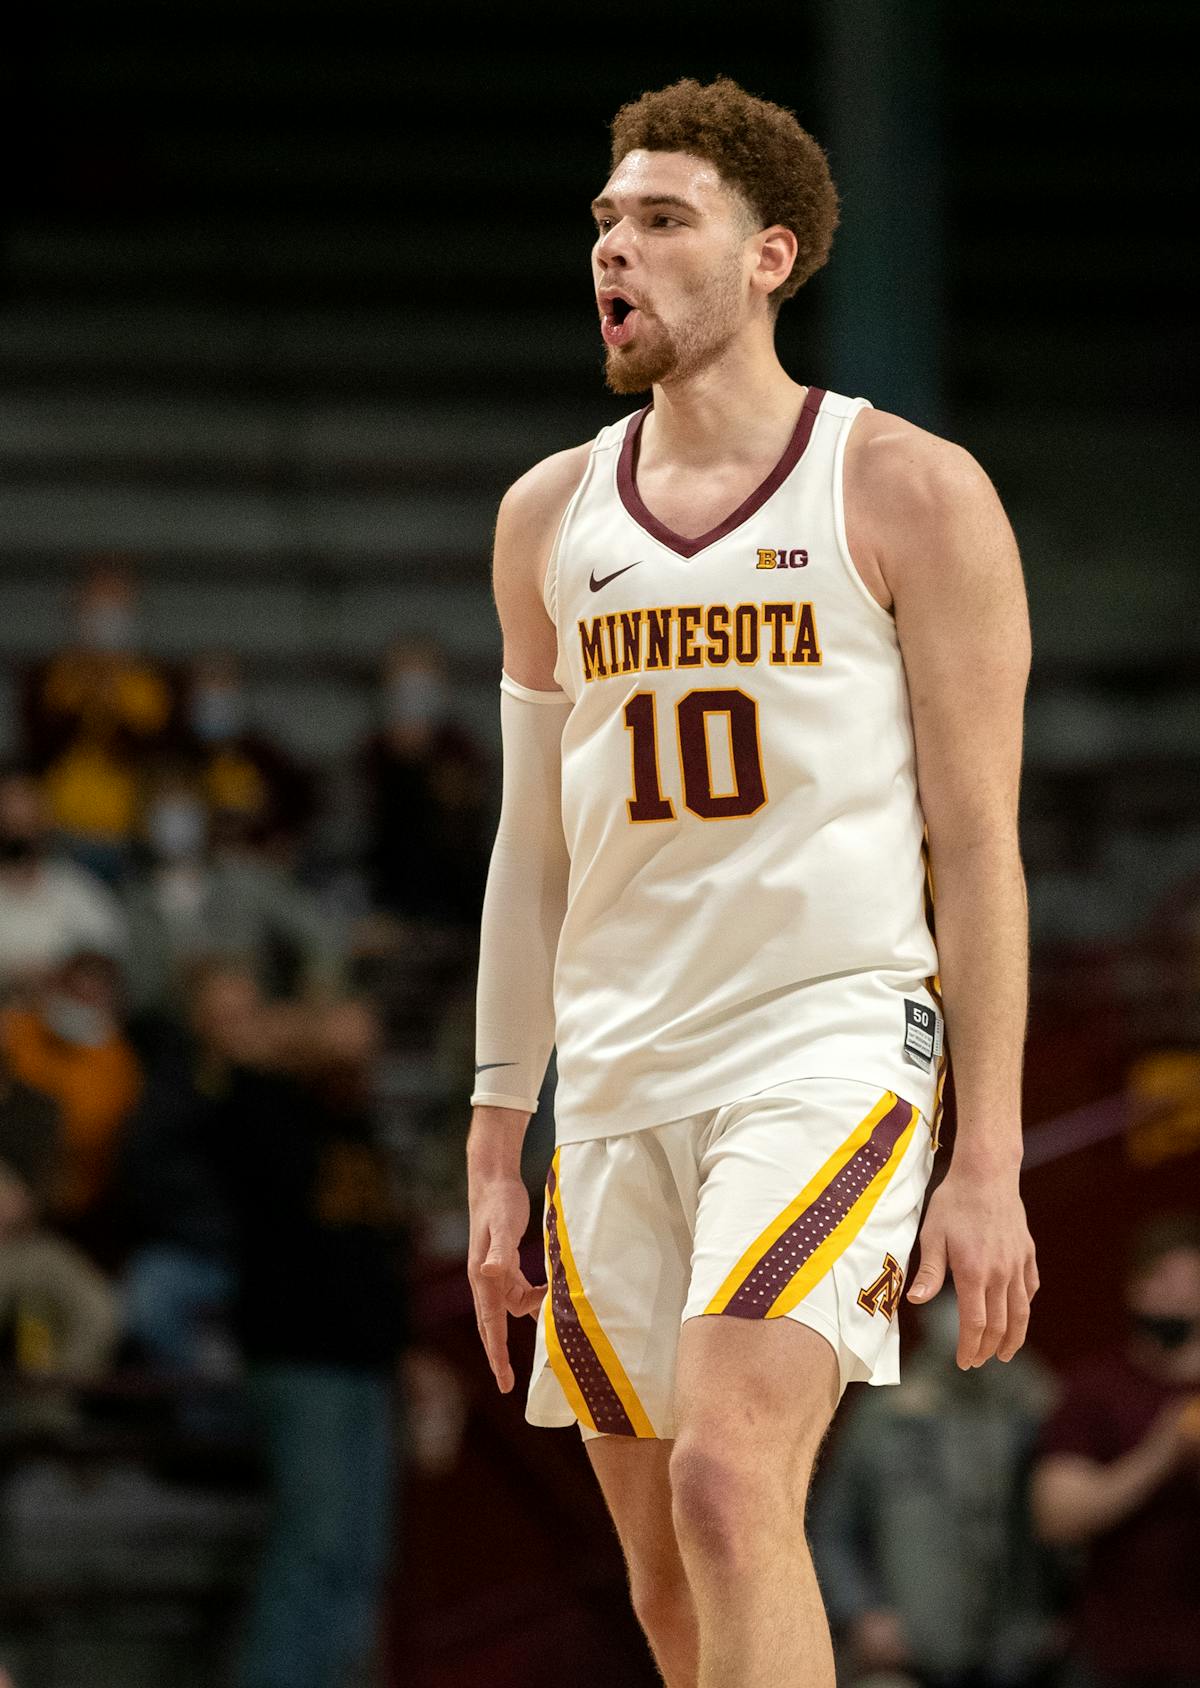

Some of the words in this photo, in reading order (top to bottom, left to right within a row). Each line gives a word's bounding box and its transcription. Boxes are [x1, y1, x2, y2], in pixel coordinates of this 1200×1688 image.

[577, 602, 822, 682] MINNESOTA
[623, 687, 769, 824] 10
[913, 1007, 929, 1027] 50
